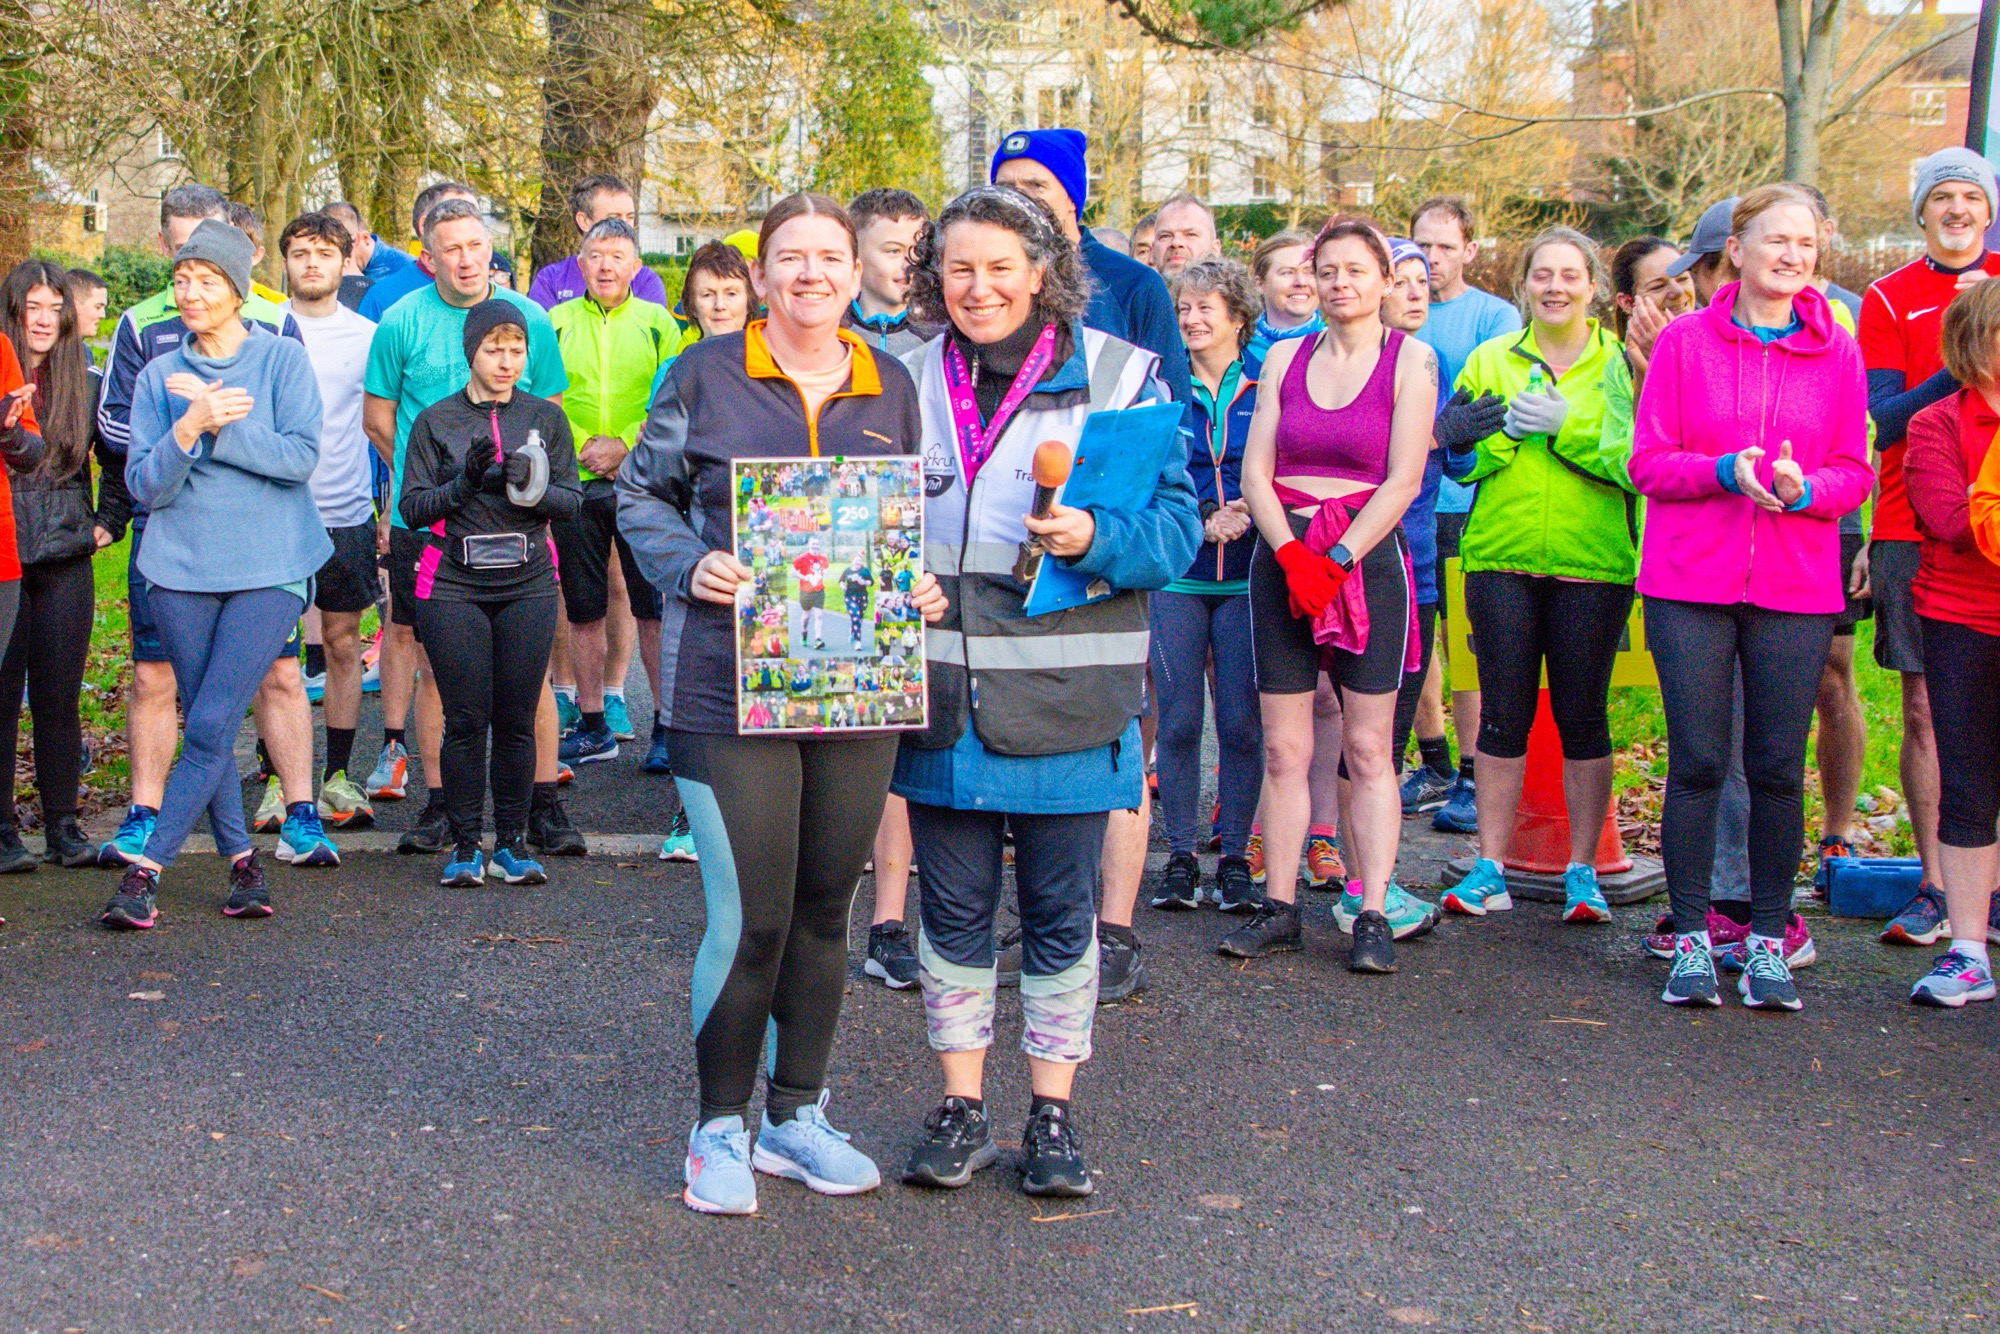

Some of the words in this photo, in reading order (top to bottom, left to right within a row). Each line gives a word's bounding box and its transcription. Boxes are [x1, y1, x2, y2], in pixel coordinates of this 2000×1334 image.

[1016, 352, 1038, 388] QUEST
[1015, 469, 1034, 482] Tra
[837, 506, 869, 525] 250
